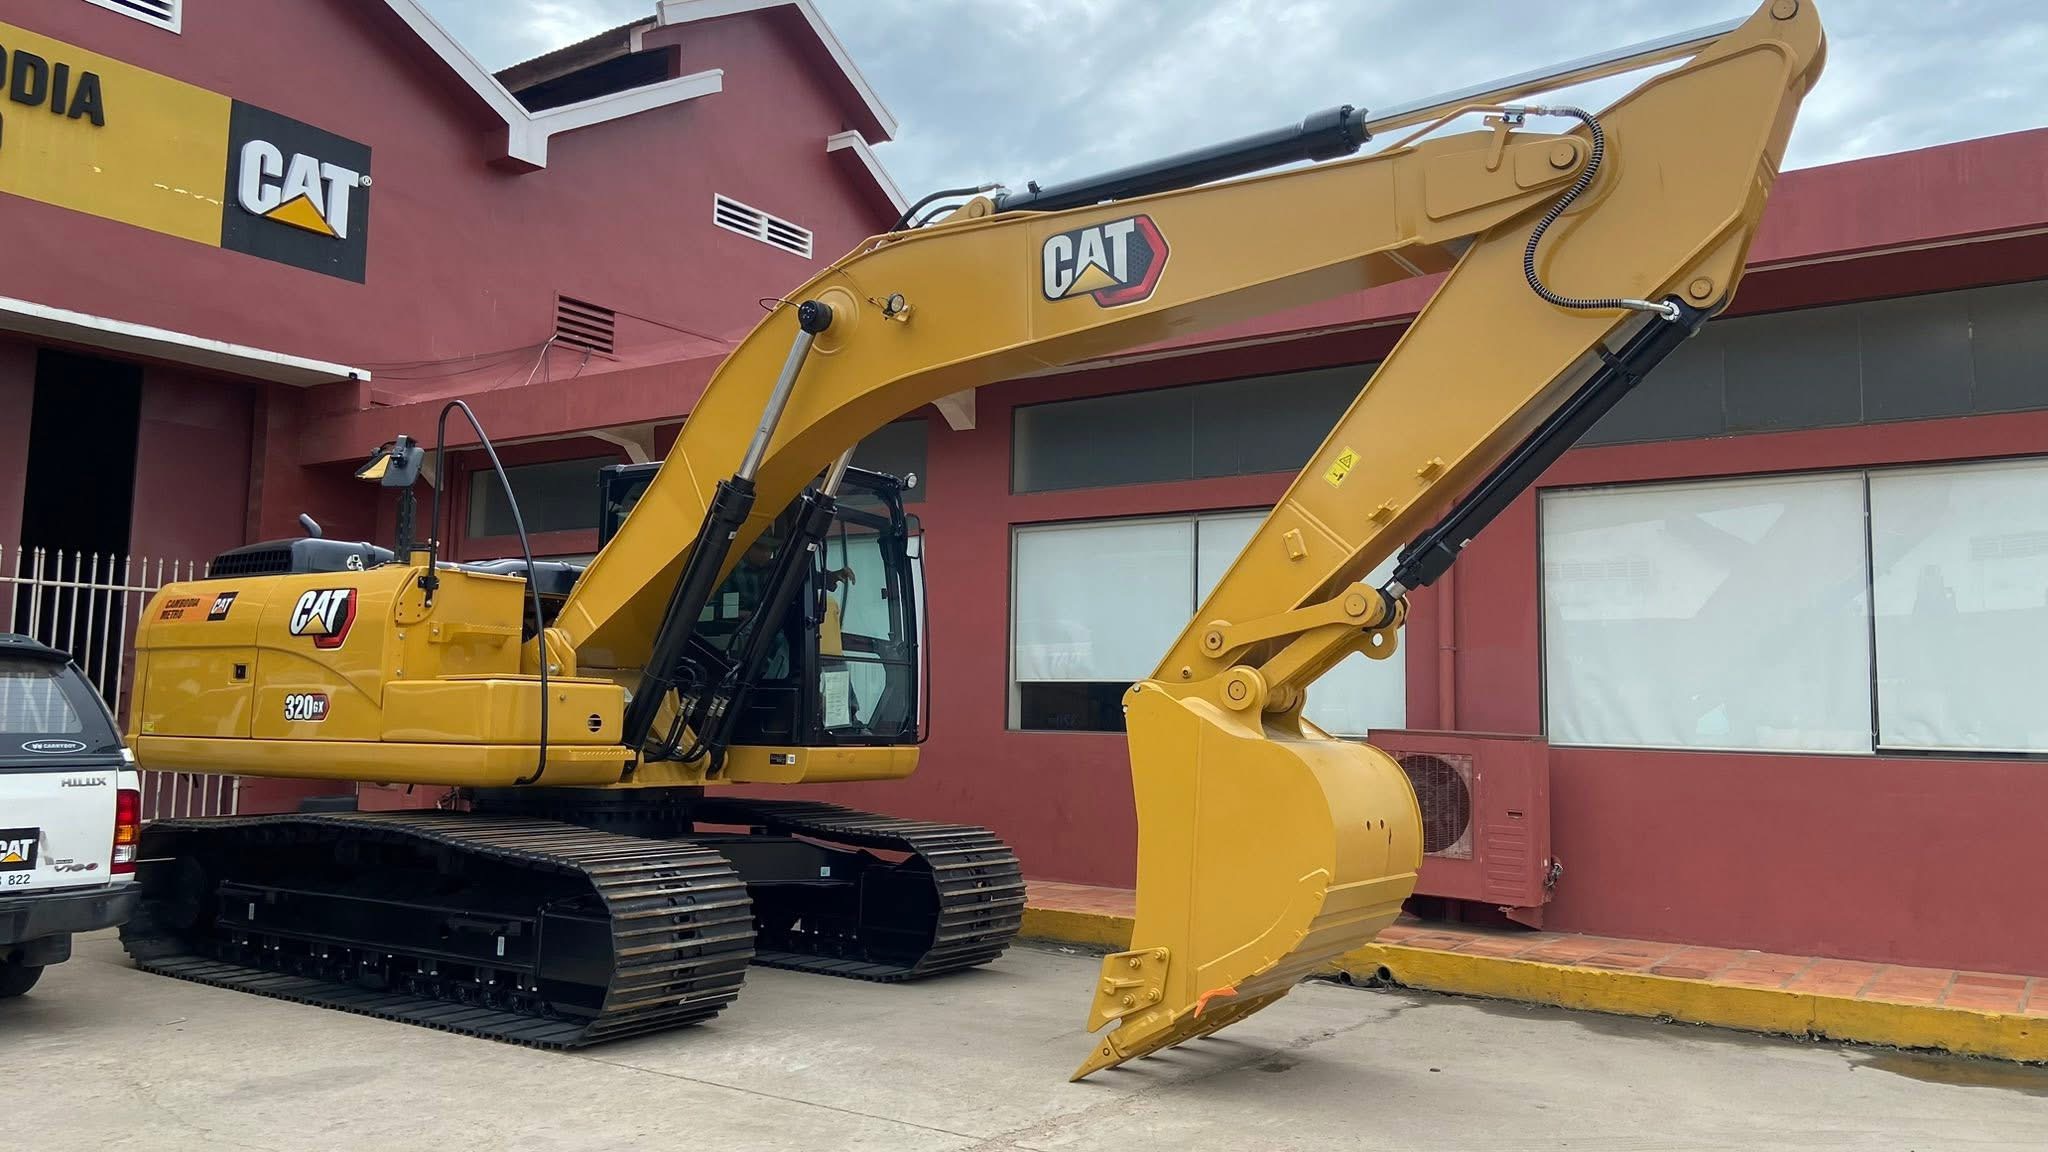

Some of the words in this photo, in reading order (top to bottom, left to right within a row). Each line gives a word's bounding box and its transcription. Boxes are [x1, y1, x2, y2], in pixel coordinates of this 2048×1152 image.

[0, 43, 105, 127] DIA
[1043, 218, 1135, 299] CAT
[211, 598, 233, 614] CAT
[290, 589, 350, 635] CAT
[61, 777, 107, 788] HILUX
[8, 874, 31, 885] 822
